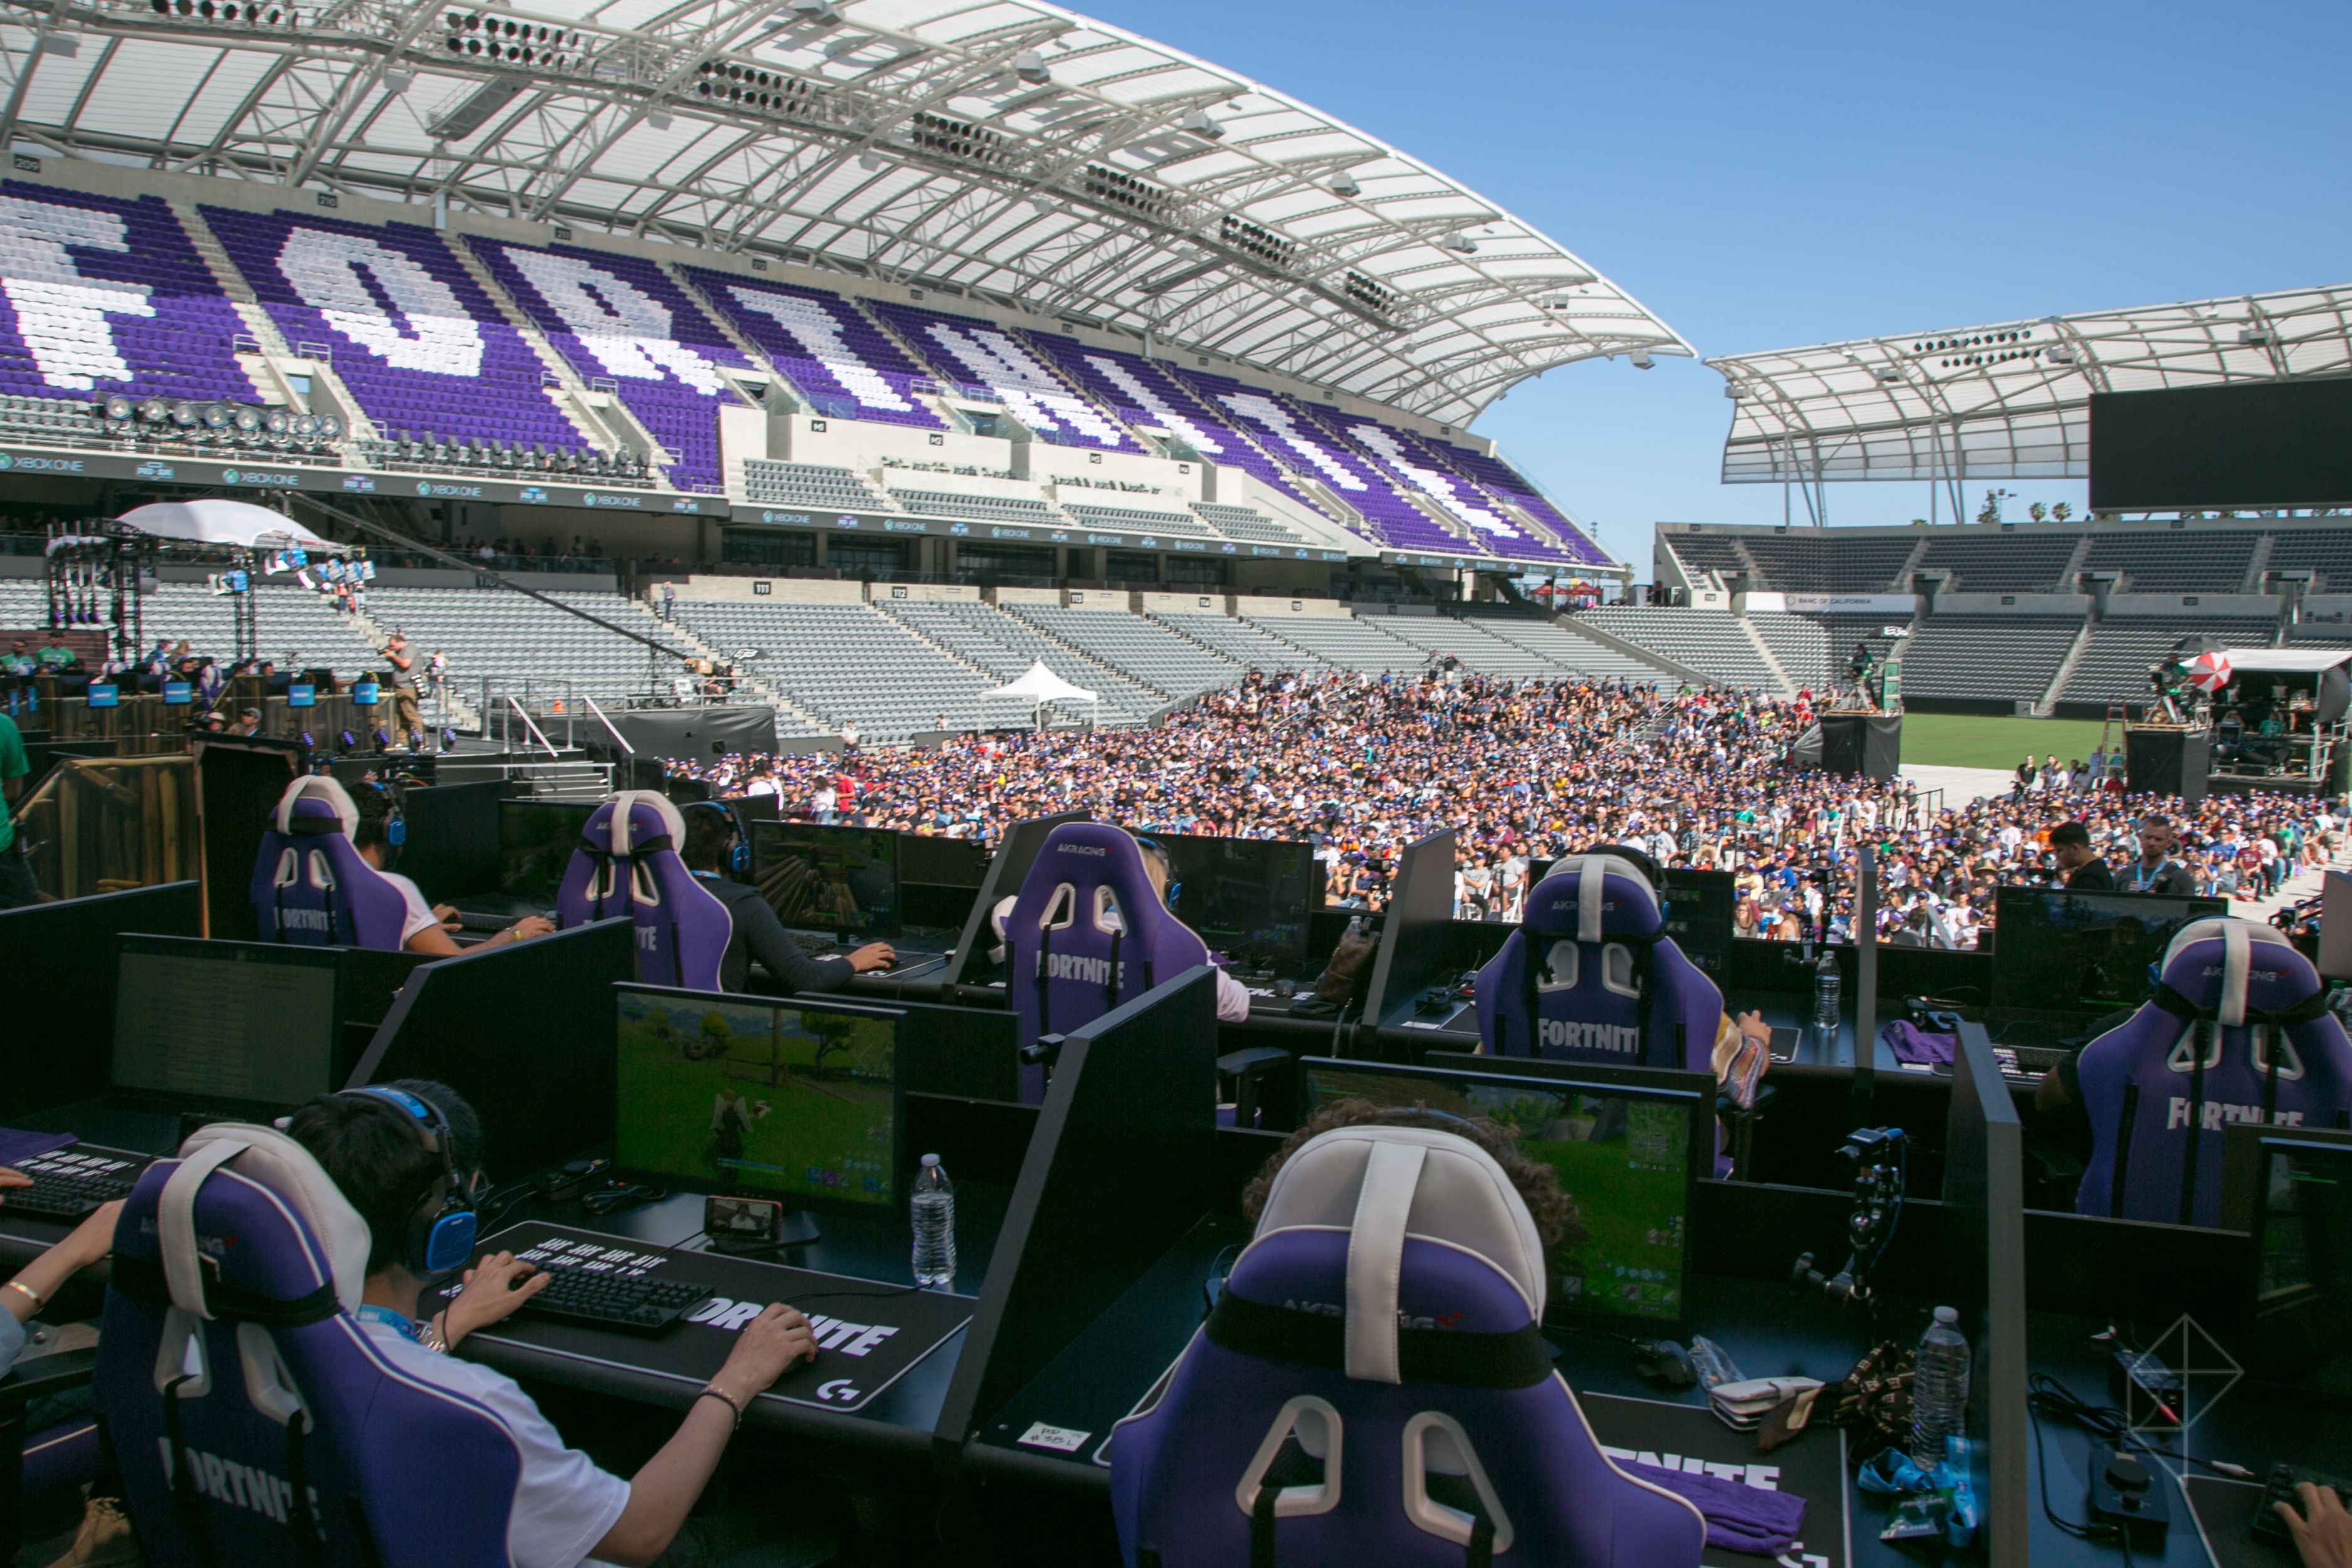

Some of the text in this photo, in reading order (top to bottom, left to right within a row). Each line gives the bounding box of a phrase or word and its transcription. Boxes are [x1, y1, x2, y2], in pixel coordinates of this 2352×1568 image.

[319, 196, 337, 207] 210
[14, 457, 85, 471] XBOX ONE
[240, 472, 299, 485] XBOX ONE
[432, 484, 482, 497] XBOX ONE
[597, 495, 640, 506] XBOX ONE
[756, 584, 770, 593] 111
[894, 588, 907, 598] 112
[1537, 1017, 1640, 1054] FORTNIT
